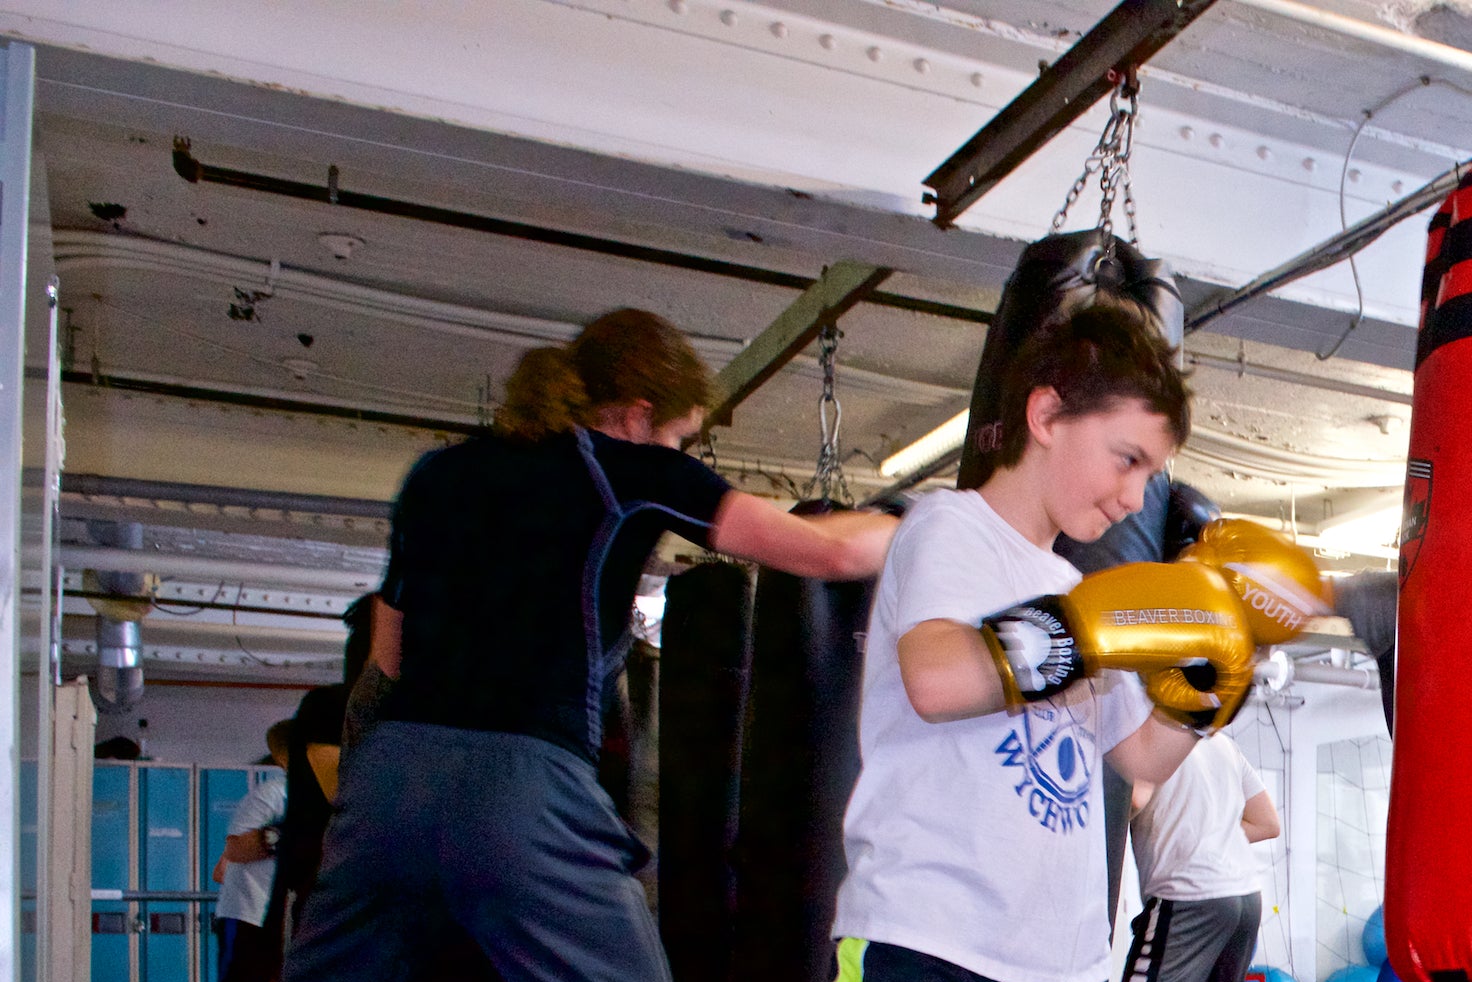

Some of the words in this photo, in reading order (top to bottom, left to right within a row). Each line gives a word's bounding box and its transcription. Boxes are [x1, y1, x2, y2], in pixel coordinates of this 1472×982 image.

[1113, 608, 1178, 626] BEAVER
[1242, 583, 1302, 631] YOUTH
[1047, 637, 1074, 685] Boxing
